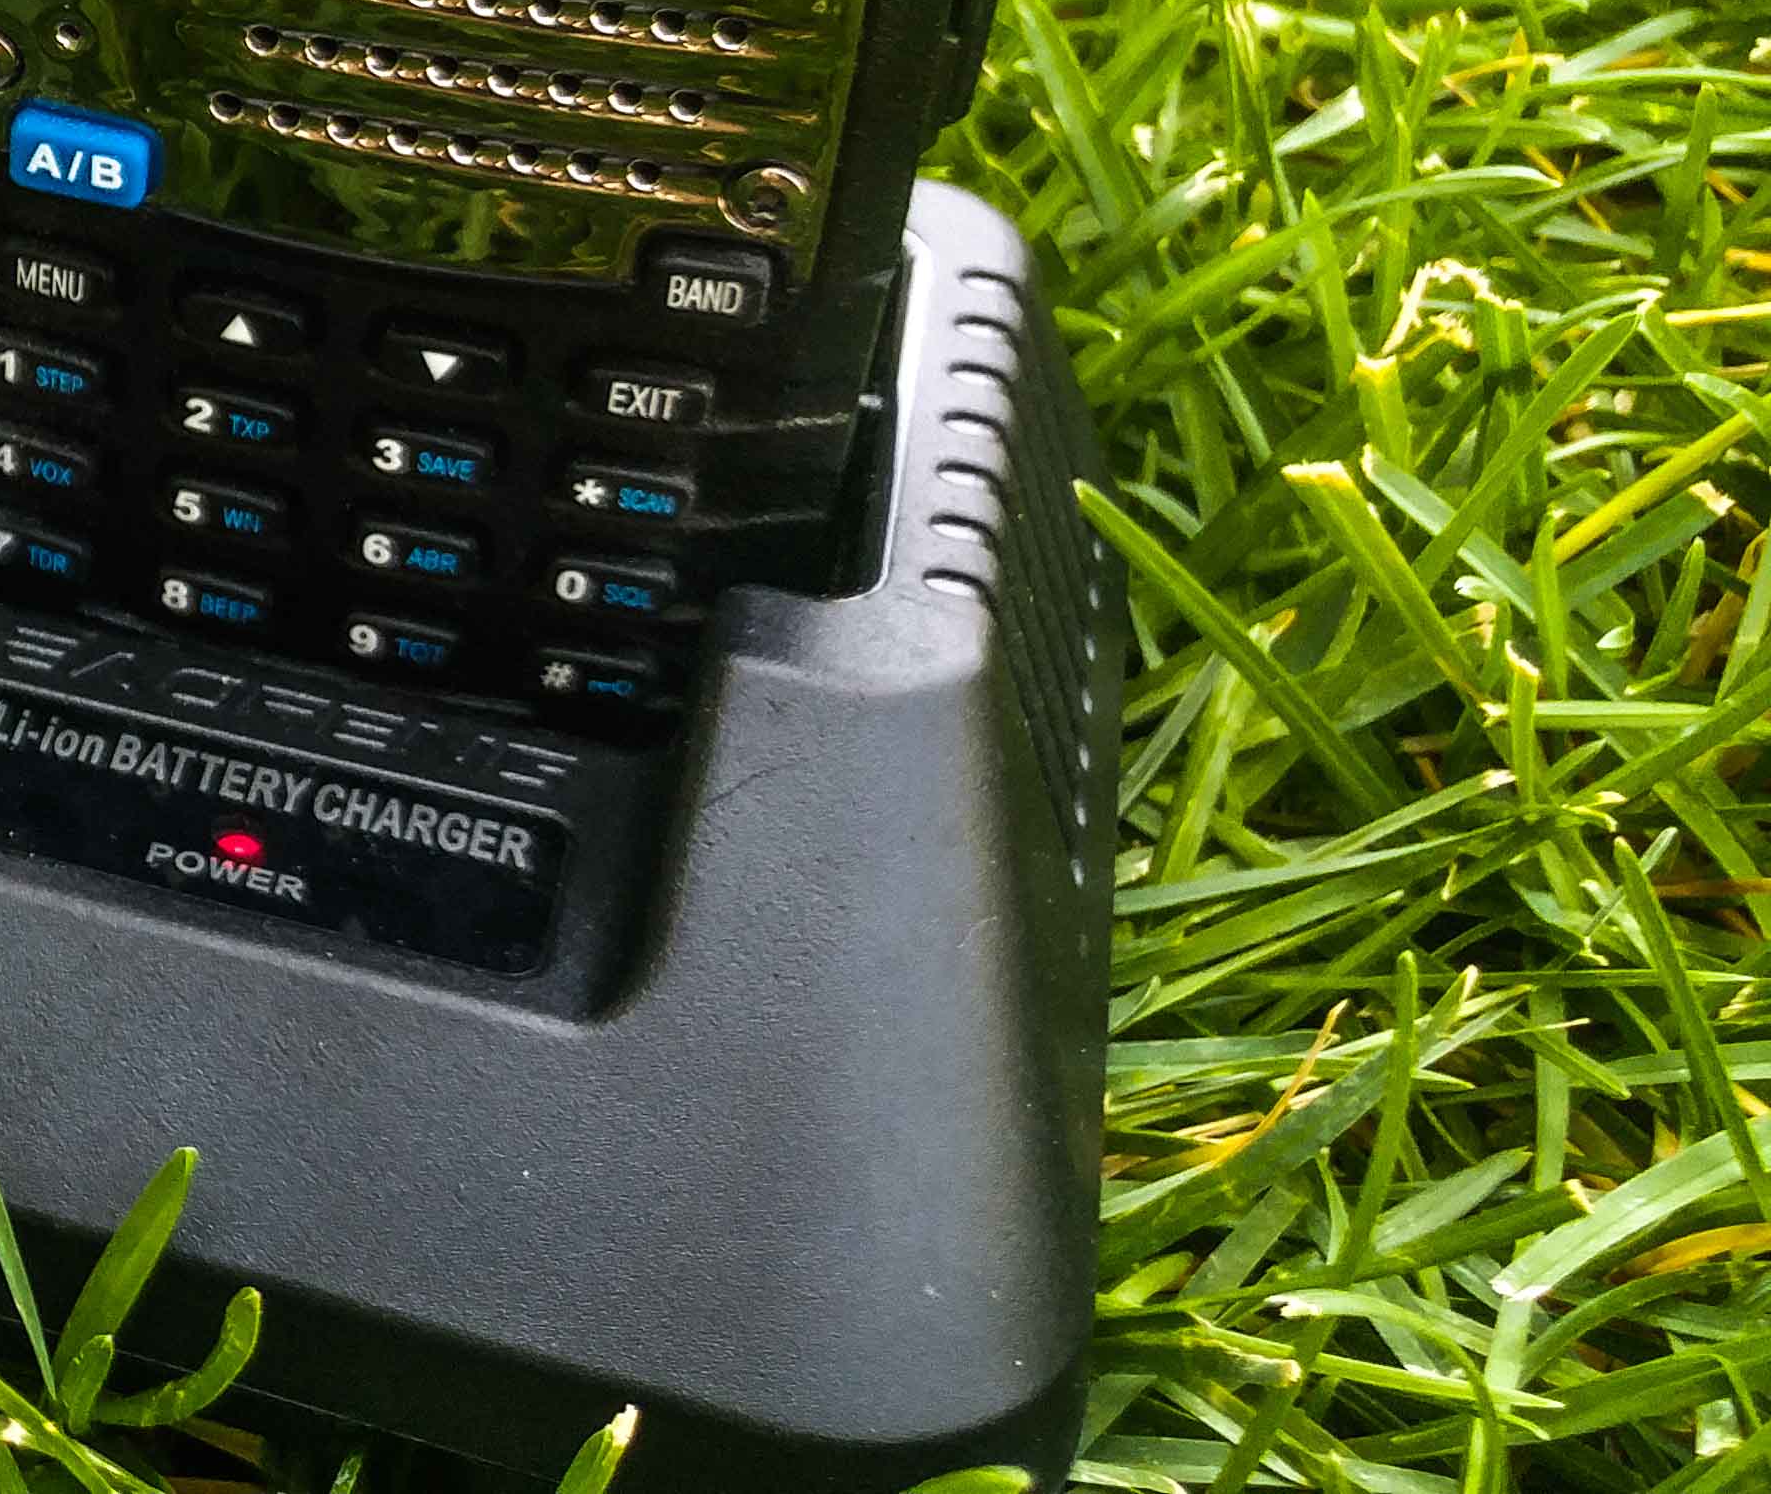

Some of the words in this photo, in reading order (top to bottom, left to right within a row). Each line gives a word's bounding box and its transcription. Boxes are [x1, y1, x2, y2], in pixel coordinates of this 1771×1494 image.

[23, 139, 126, 193] A/B
[16, 257, 84, 303] MENU
[666, 273, 744, 316] BAND
[35, 364, 84, 395] STEP
[183, 397, 216, 434] 2
[607, 380, 685, 423] EXIT
[28, 456, 75, 486] VOX
[371, 438, 406, 474] 3
[416, 451, 478, 484] SAVE
[172, 490, 202, 523] 5
[361, 532, 395, 567] 6
[161, 578, 191, 611] 8
[347, 623, 381, 656] 9
[108, 734, 315, 816] BATTERY
[312, 781, 536, 870] CHARGER
[145, 840, 308, 904] POWER
